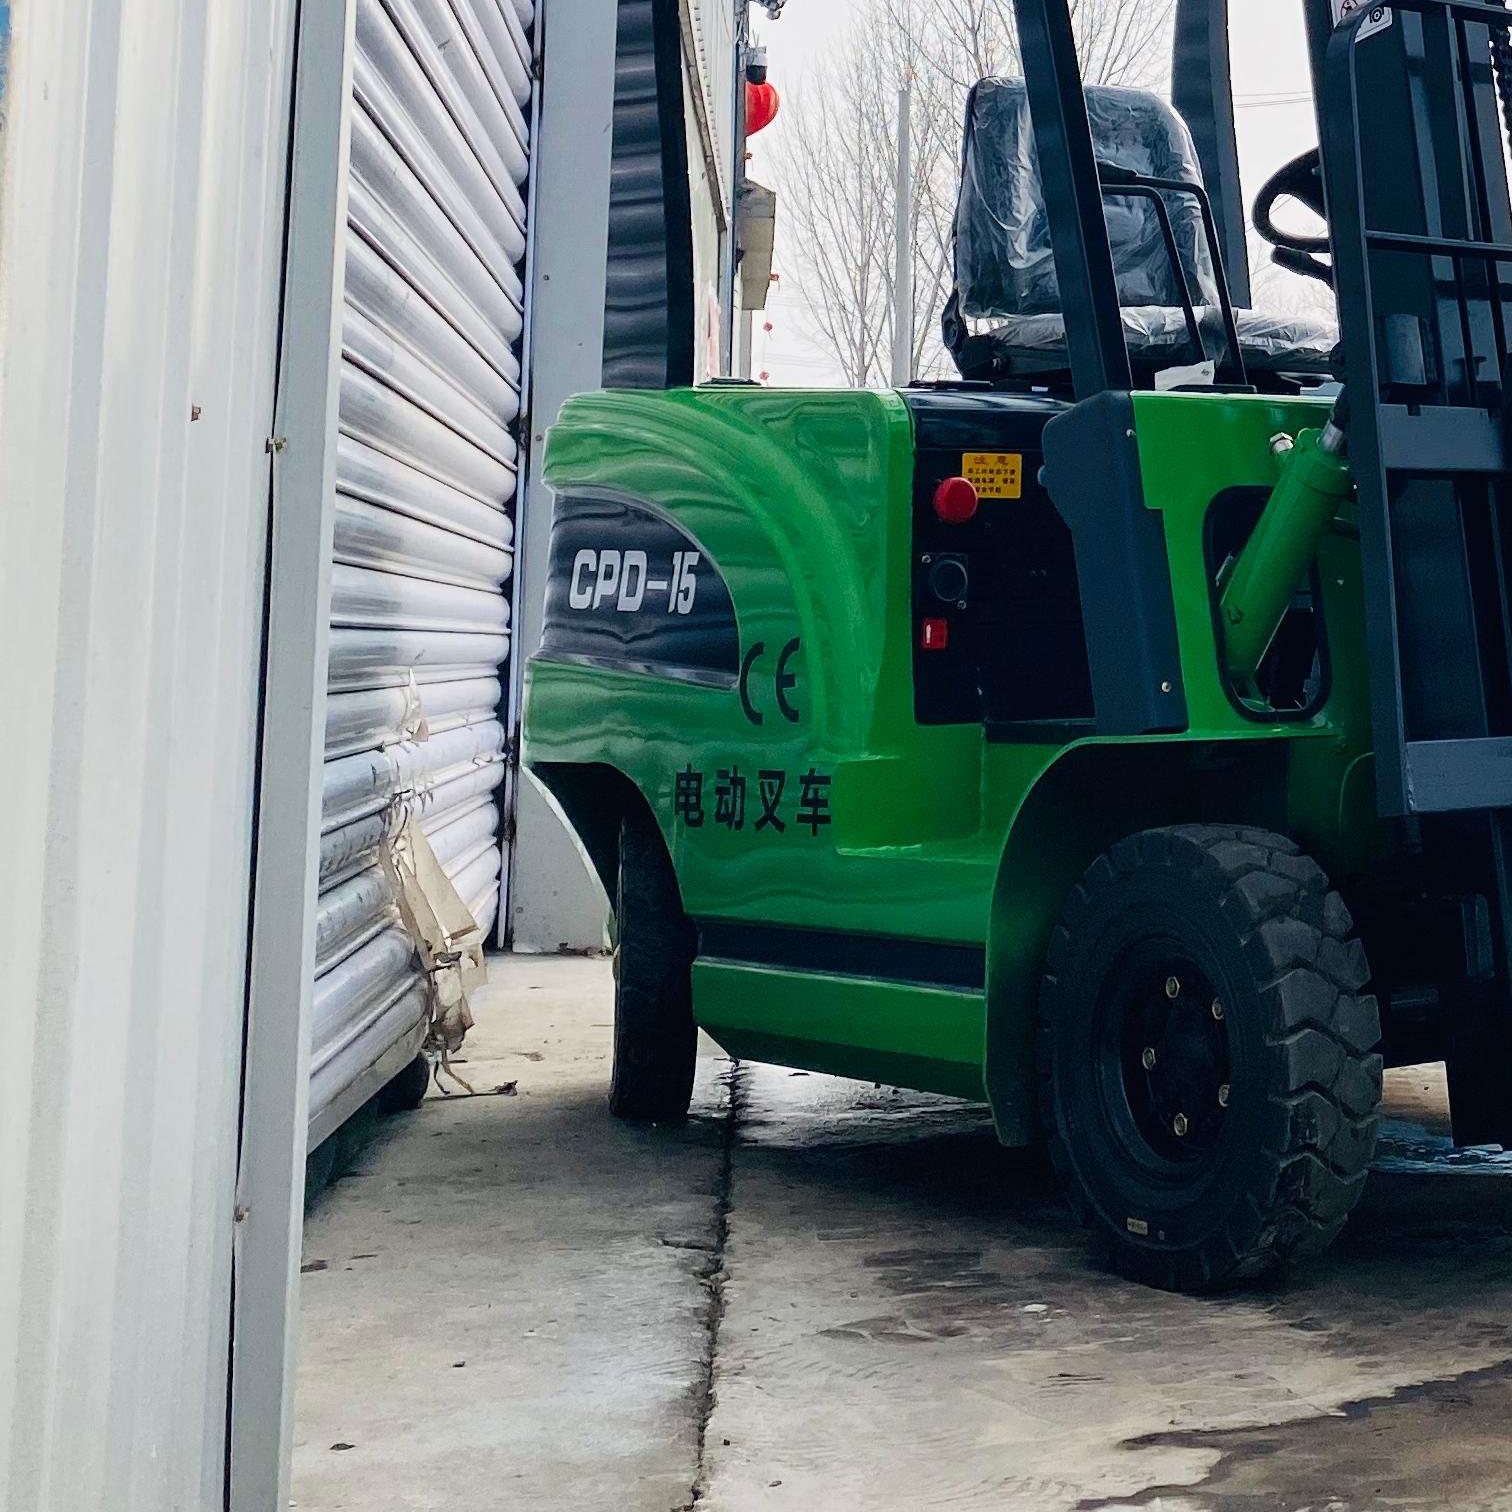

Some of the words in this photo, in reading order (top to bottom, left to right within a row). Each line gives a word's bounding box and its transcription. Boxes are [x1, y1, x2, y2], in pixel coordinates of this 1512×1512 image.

[568, 549, 700, 615] CPD-15
[739, 637, 800, 727] CE
[673, 763, 832, 837] 电动叉车
